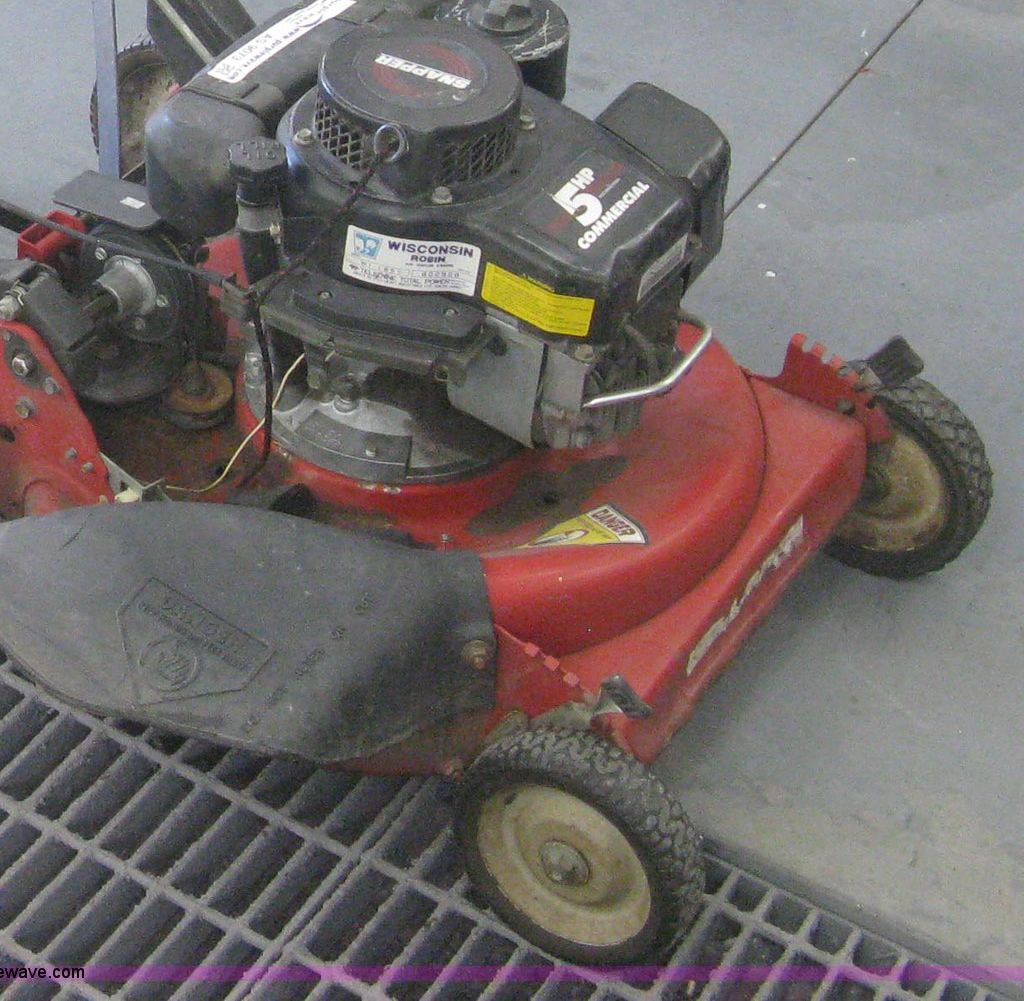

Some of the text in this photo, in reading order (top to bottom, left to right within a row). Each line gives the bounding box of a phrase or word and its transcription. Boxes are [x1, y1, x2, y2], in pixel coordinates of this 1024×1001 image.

[374, 52, 472, 89] SNAPPER
[570, 166, 595, 190] HP
[577, 180, 650, 250] COMMERCIAL
[388, 240, 474, 258] WISCONSIN
[410, 254, 446, 263] ROBIN
